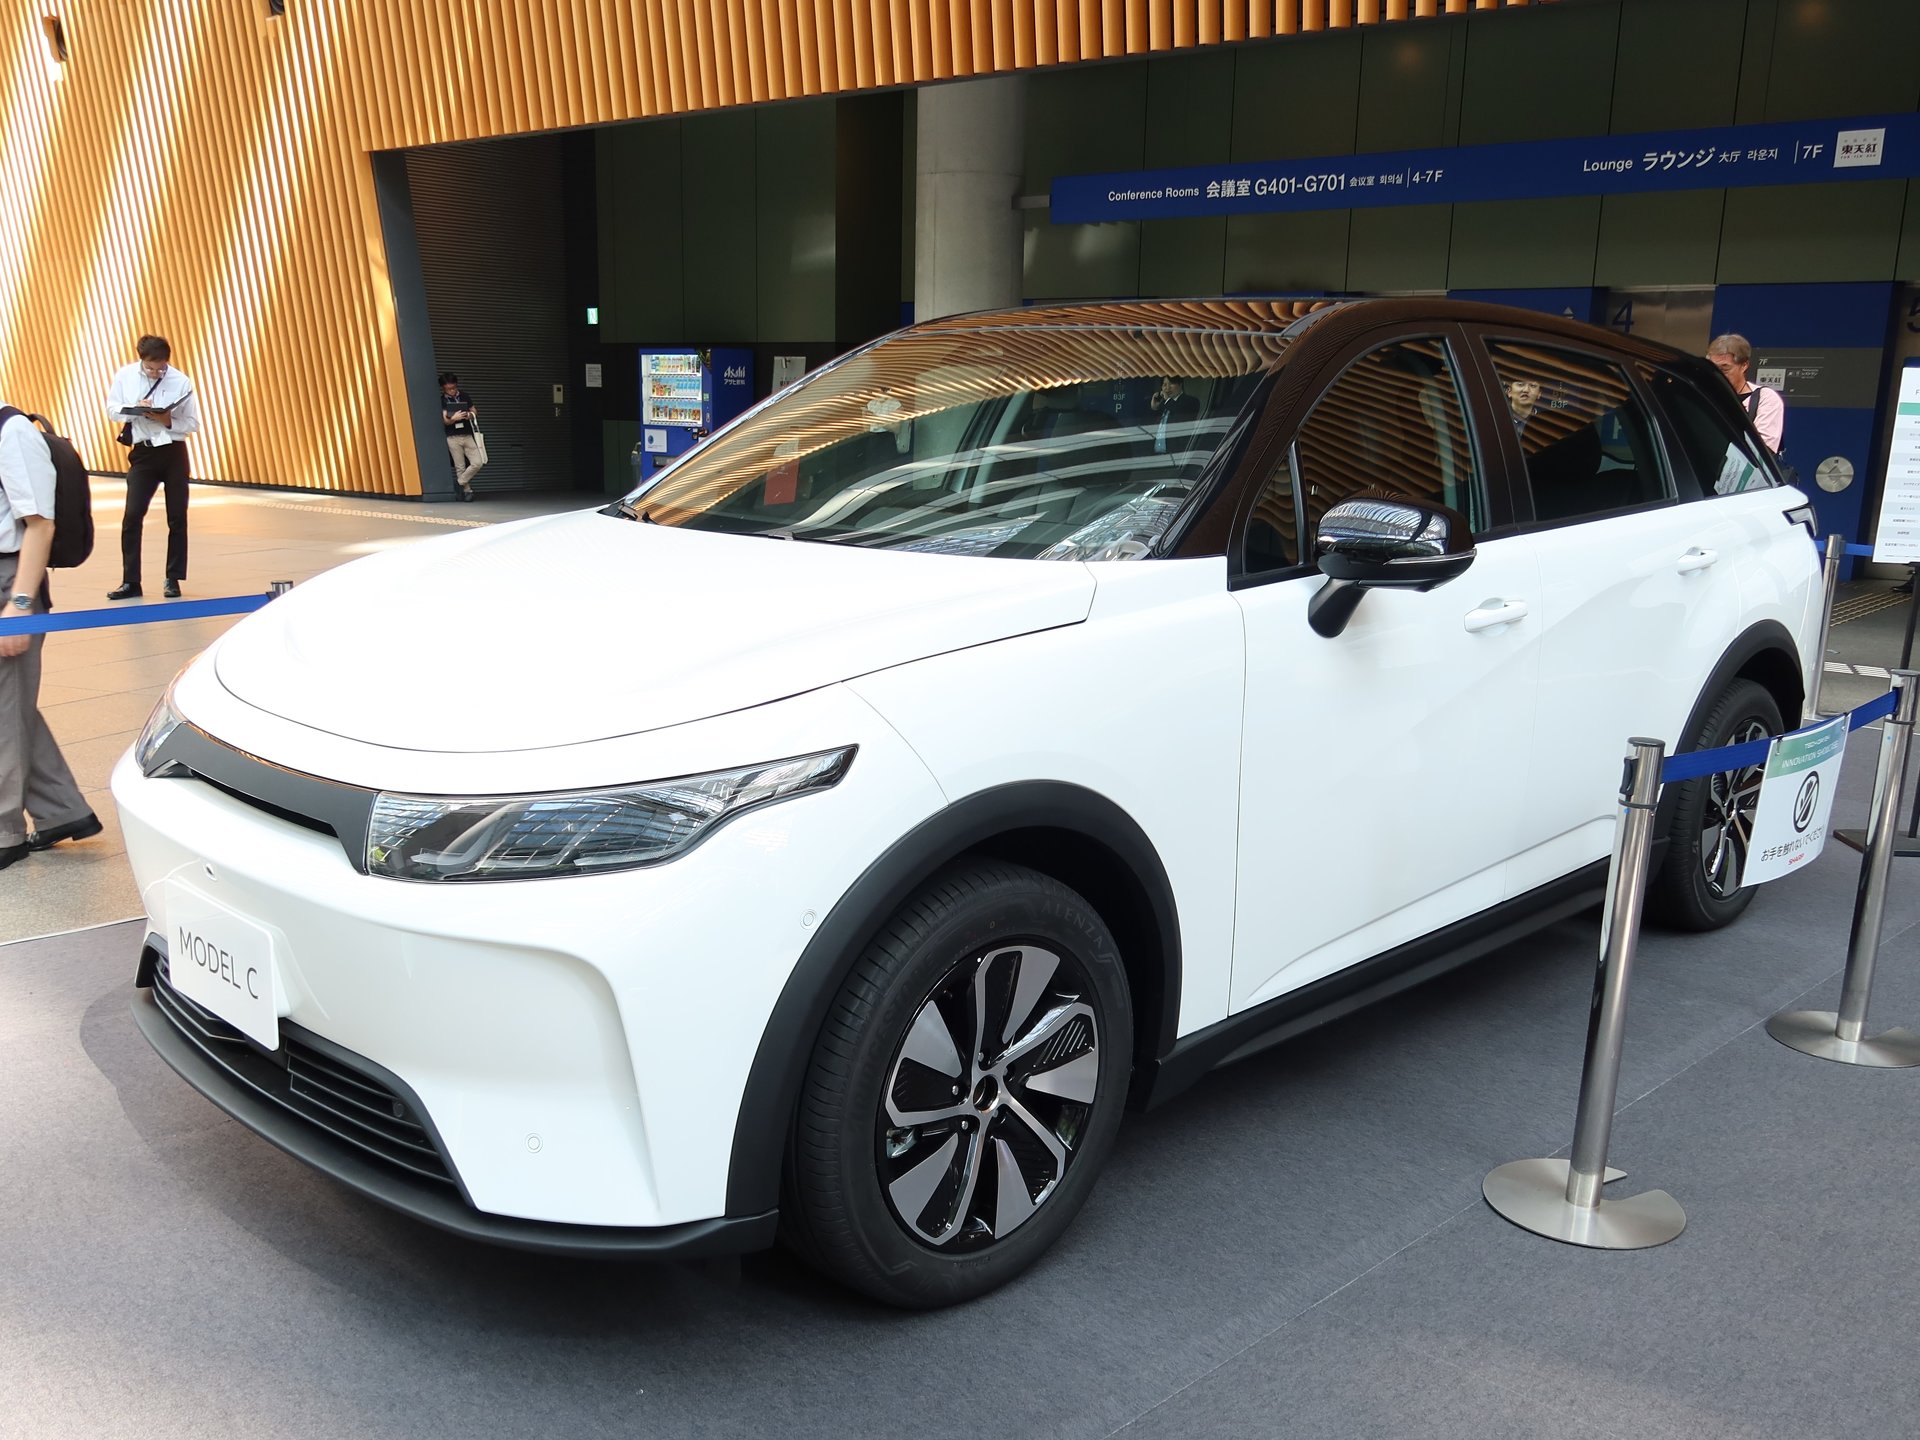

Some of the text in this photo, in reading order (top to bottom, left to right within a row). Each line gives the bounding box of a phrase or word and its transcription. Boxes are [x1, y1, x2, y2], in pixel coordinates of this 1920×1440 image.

[1583, 158, 1633, 173] Lounge
[1642, 146, 1716, 171] ラウンジ
[1747, 148, 1778, 161] 라운지
[1803, 143, 1824, 159] 7F
[1841, 143, 1878, 155] 東天紅
[1108, 188, 1163, 202] Conference
[1165, 186, 1200, 199] Rooms
[1206, 178, 1251, 199] 会議室
[1254, 173, 1346, 196] G401-G701
[1349, 175, 1375, 187] 会议室
[1612, 299, 1635, 336] 4
[1781, 752, 1817, 769] INNOVATION
[178, 926, 259, 1000] MODEL C
